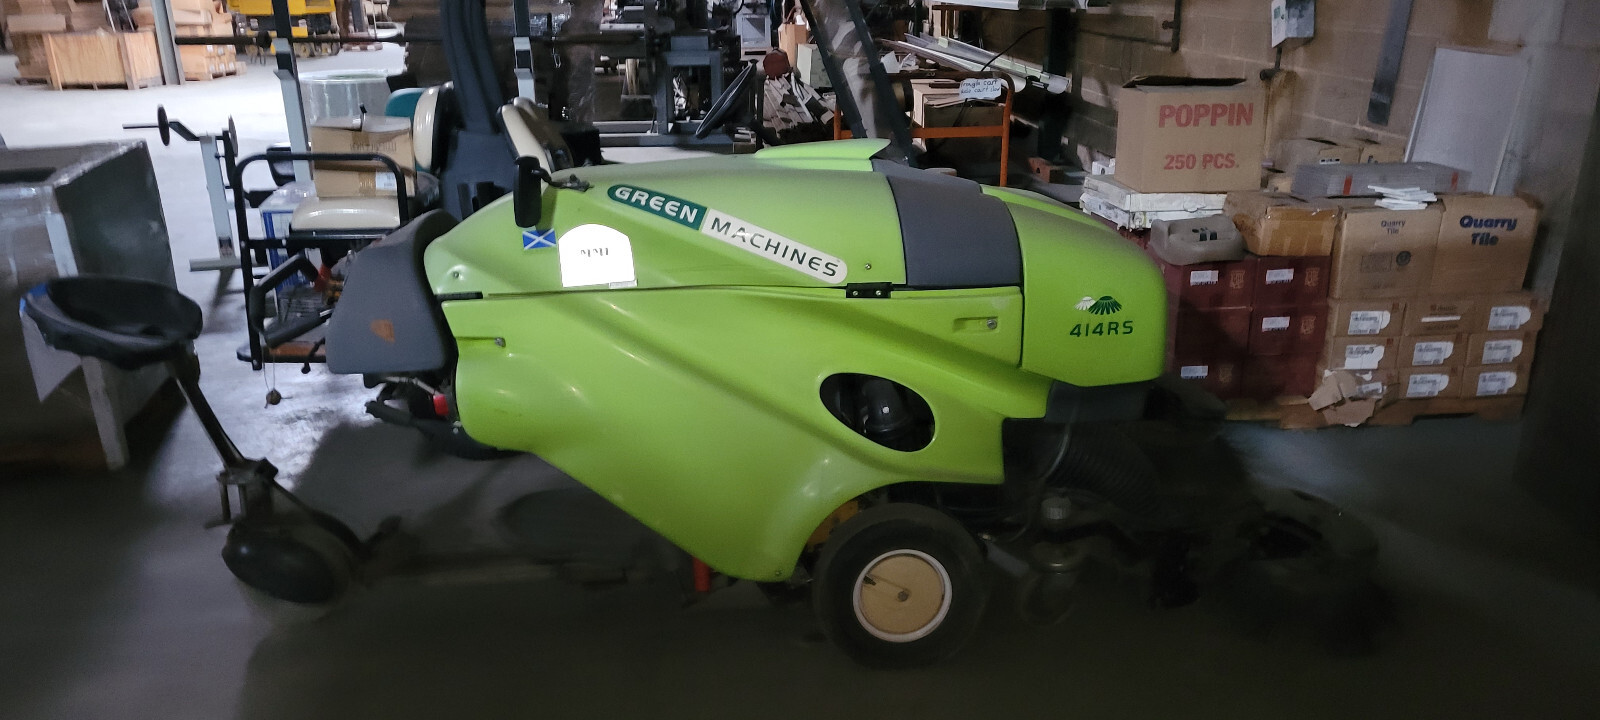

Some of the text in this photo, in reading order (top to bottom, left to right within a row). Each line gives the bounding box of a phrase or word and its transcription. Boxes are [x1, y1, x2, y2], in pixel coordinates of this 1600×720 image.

[1158, 102, 1254, 128] POPPIN
[1163, 153, 1239, 170] 250 PCS.
[1380, 219, 1406, 228] Quarry
[1459, 215, 1518, 231] Quarry
[614, 186, 839, 278] GREEN MACHINES
[1471, 232, 1499, 246] Tile
[1069, 320, 1134, 337] 414RS
